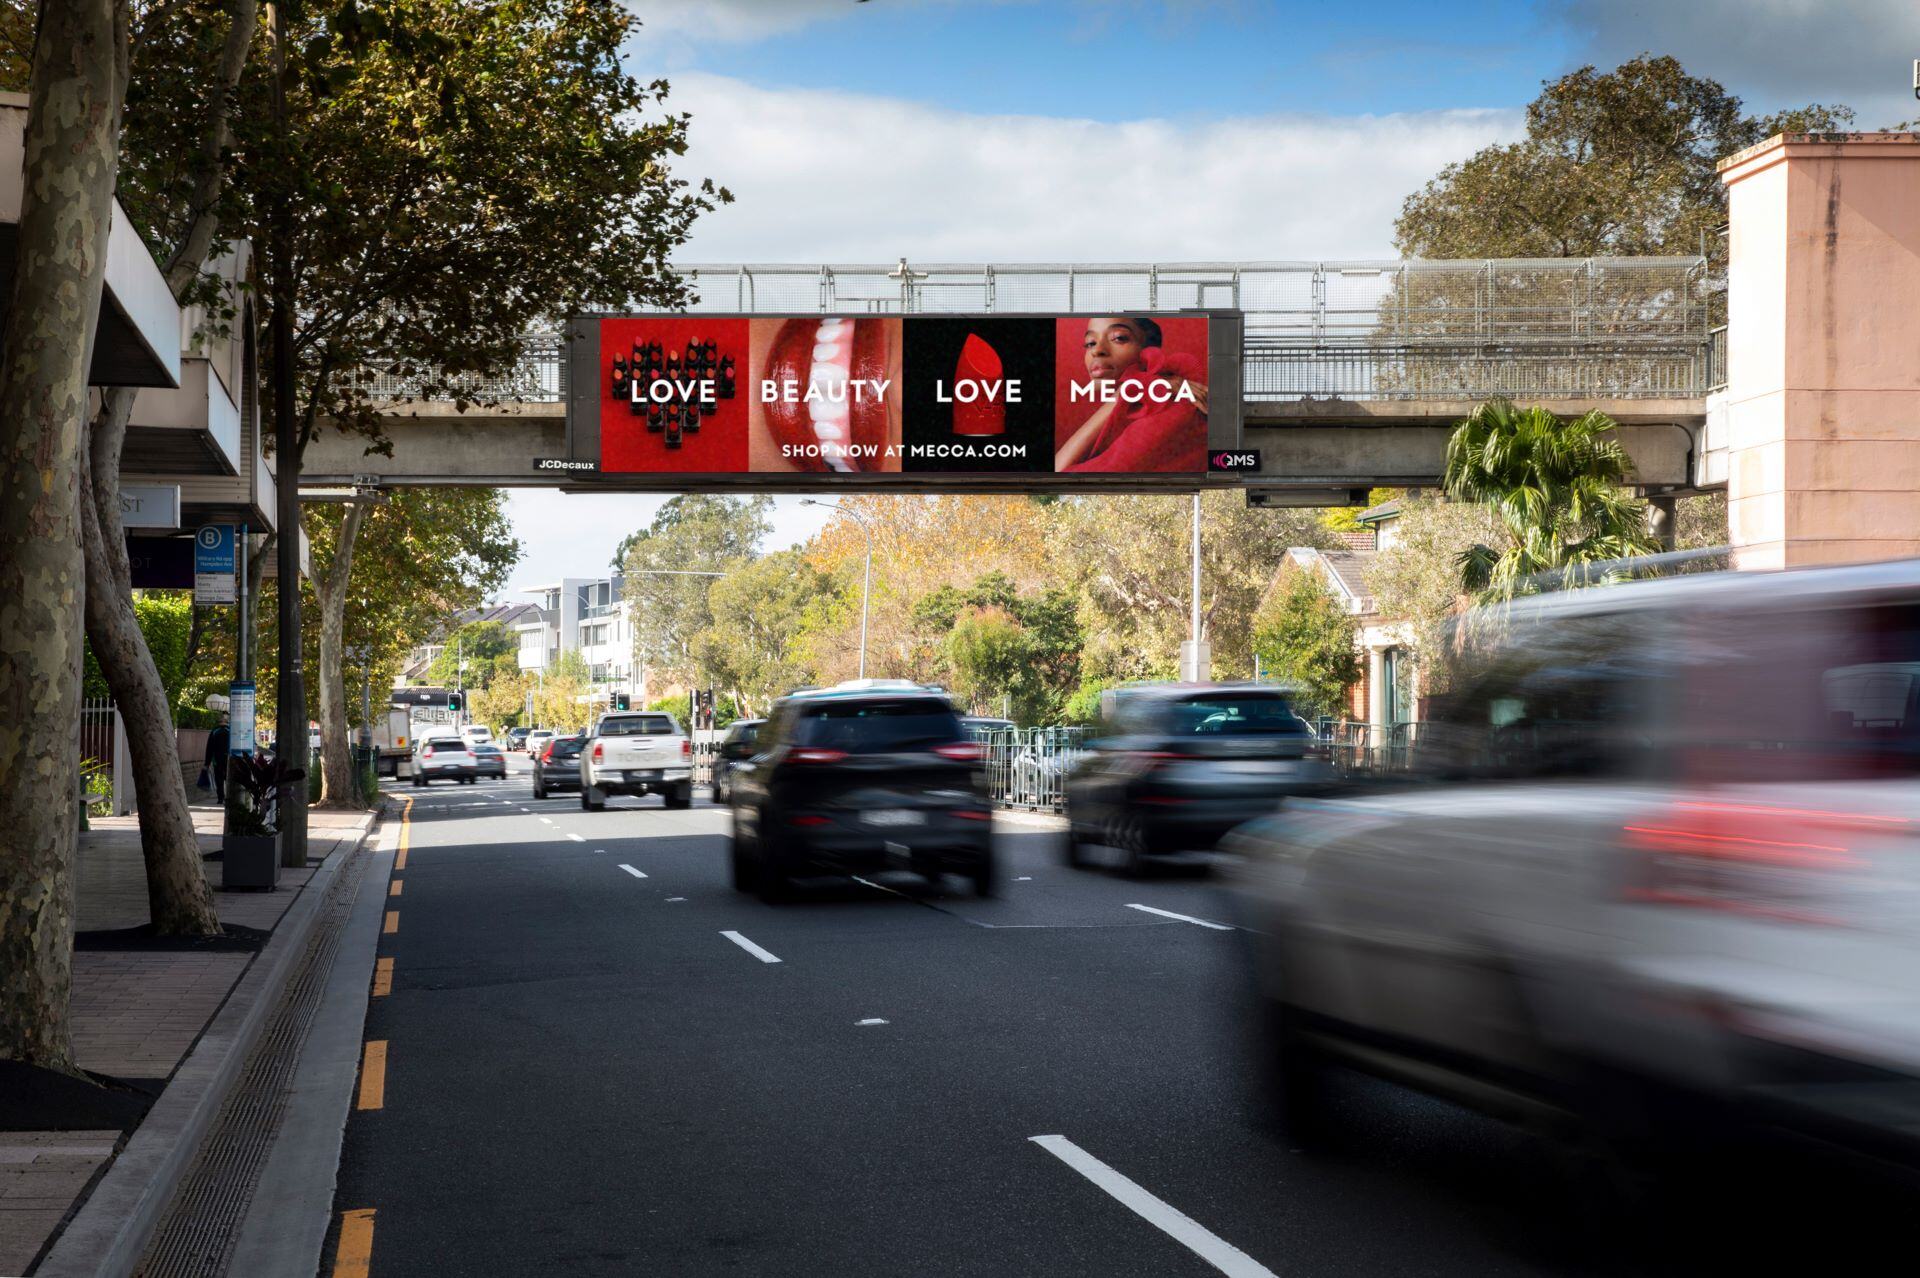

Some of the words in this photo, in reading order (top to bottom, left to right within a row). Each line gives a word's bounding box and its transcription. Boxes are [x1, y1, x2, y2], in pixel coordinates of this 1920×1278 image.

[631, 379, 716, 403] LOVE
[761, 379, 891, 403] BEAUTY
[936, 379, 1022, 403] LOVE
[1070, 379, 1197, 403] MECCA
[782, 444, 830, 457] SHOP
[836, 444, 878, 457] NOW
[884, 444, 905, 457] AT
[911, 444, 1026, 458] MECCA.COM
[539, 460, 594, 469] JCDecaux
[1220, 452, 1255, 469] QMS
[121, 499, 144, 513] ST
[205, 532, 215, 544] B
